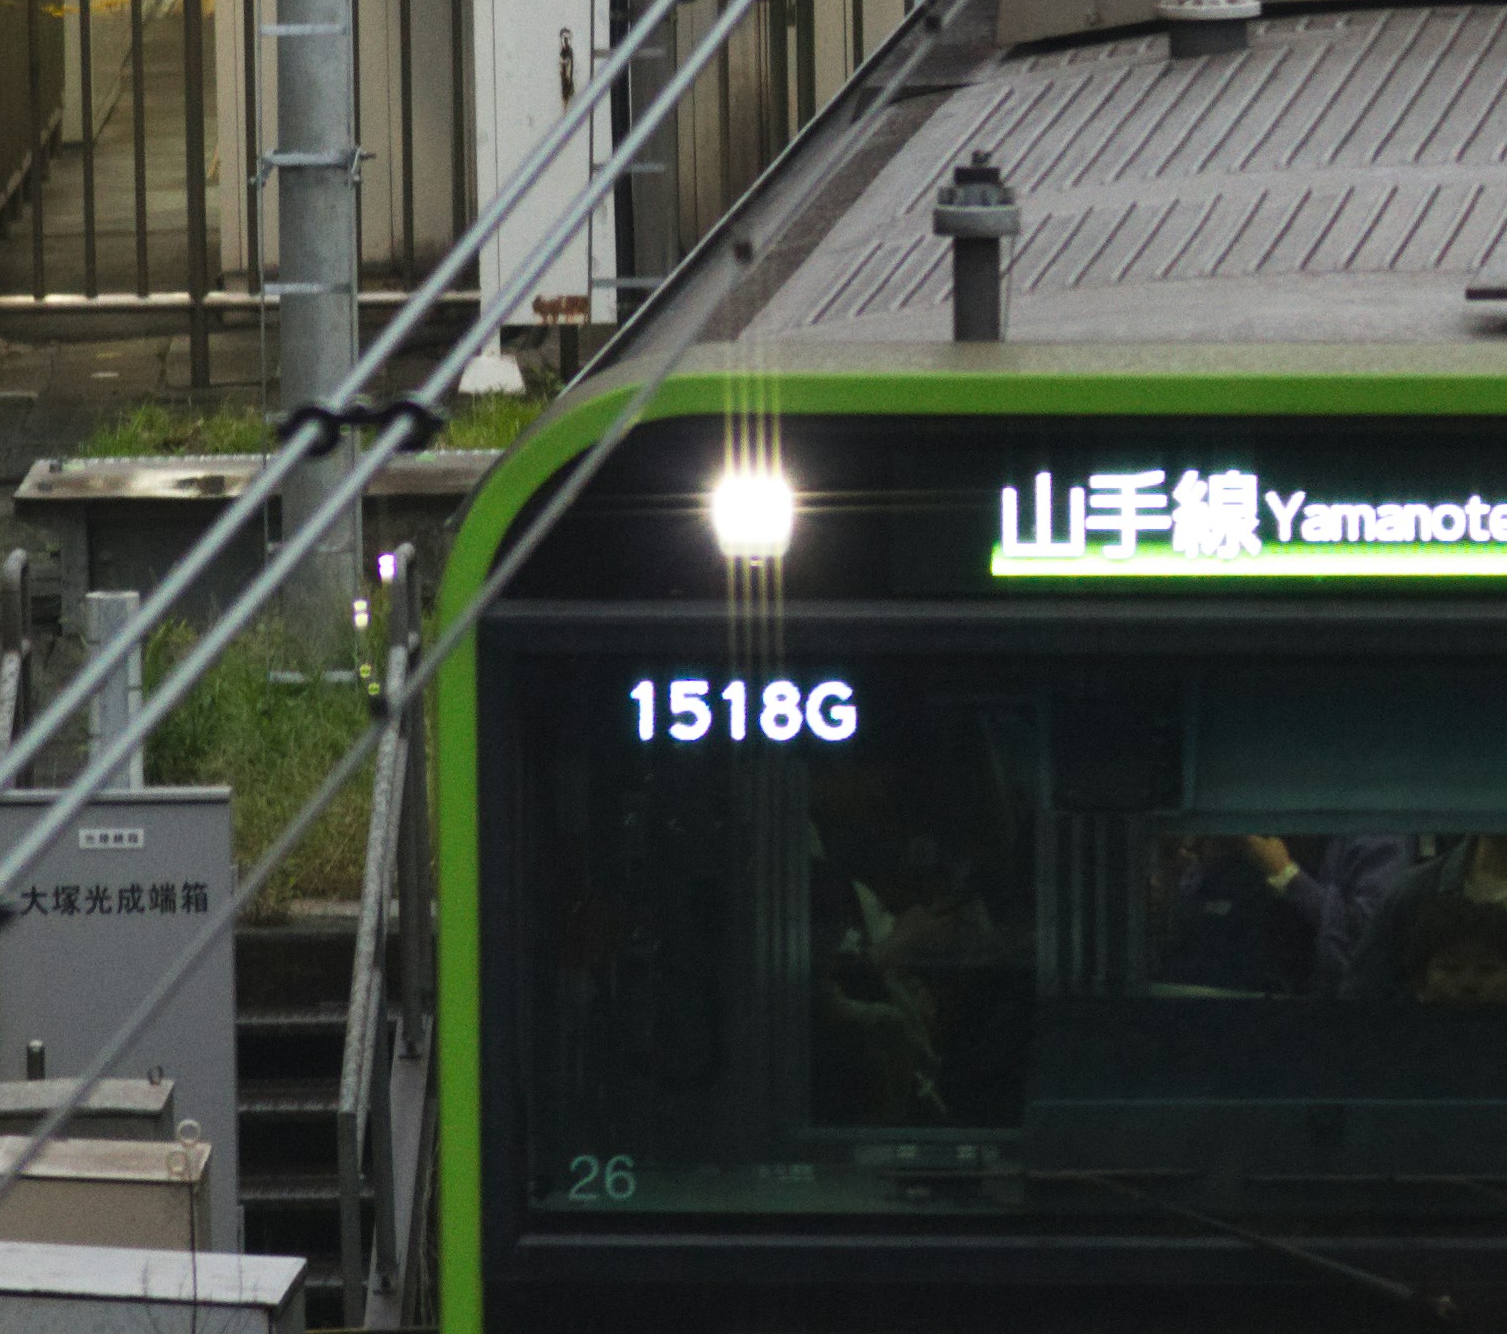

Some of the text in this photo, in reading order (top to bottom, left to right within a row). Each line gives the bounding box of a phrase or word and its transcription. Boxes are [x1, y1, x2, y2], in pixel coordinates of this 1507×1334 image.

[1000, 469, 1262, 560] 山手線
[629, 679, 858, 742] 1518G
[21, 880, 209, 915] 大塚光成端箱
[568, 1154, 637, 1201] 26
